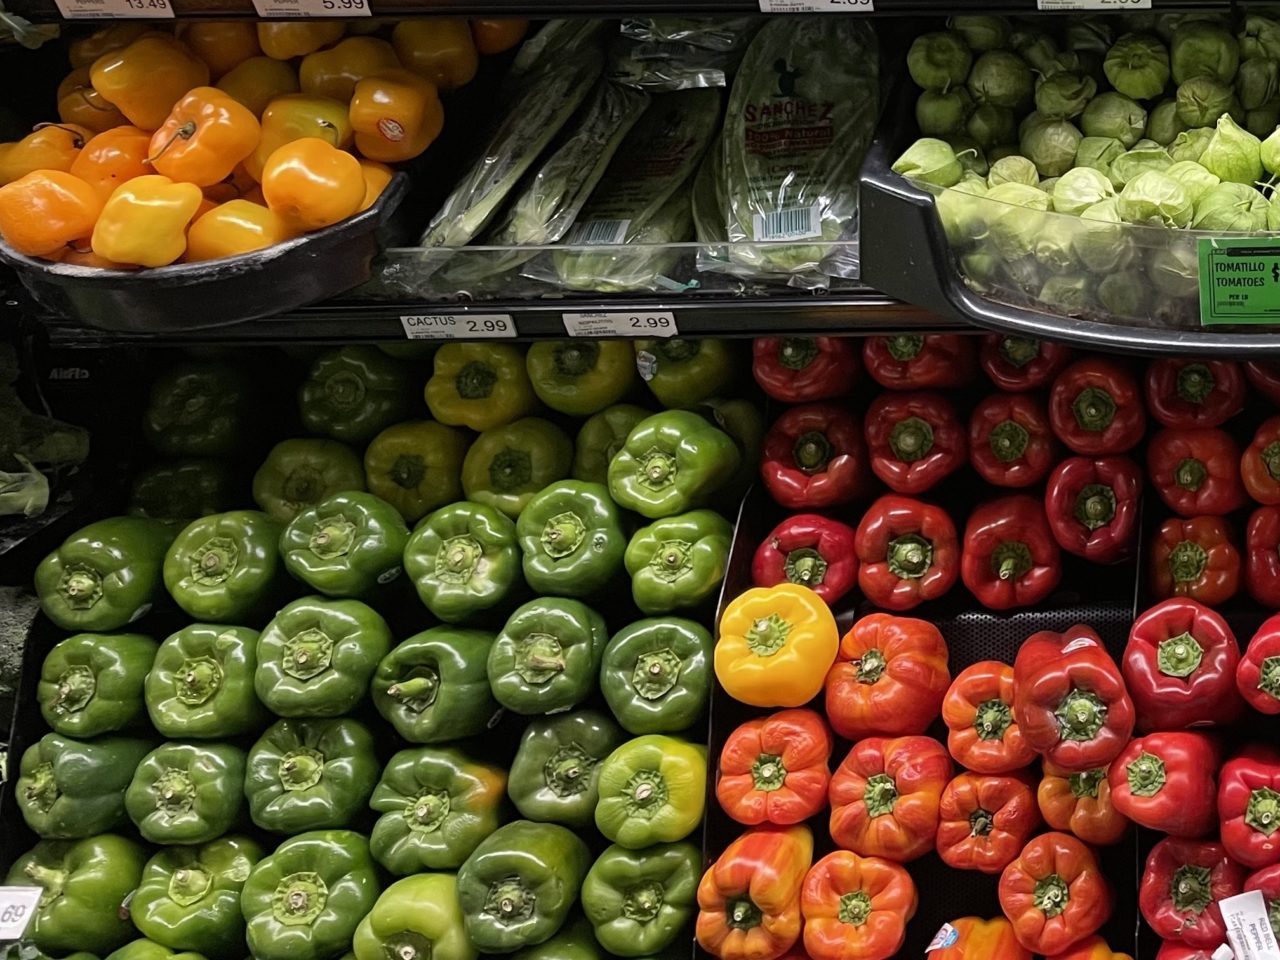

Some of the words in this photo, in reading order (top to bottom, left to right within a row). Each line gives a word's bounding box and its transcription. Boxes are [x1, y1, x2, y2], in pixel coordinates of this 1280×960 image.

[745, 100, 835, 122] SANCHEZ
[1215, 262, 1265, 272] TOMATILLO
[1216, 277, 1265, 287] TOMATOES
[407, 316, 456, 327] CACTUS
[466, 319, 507, 332] 2.99
[629, 316, 670, 328] 2.99
